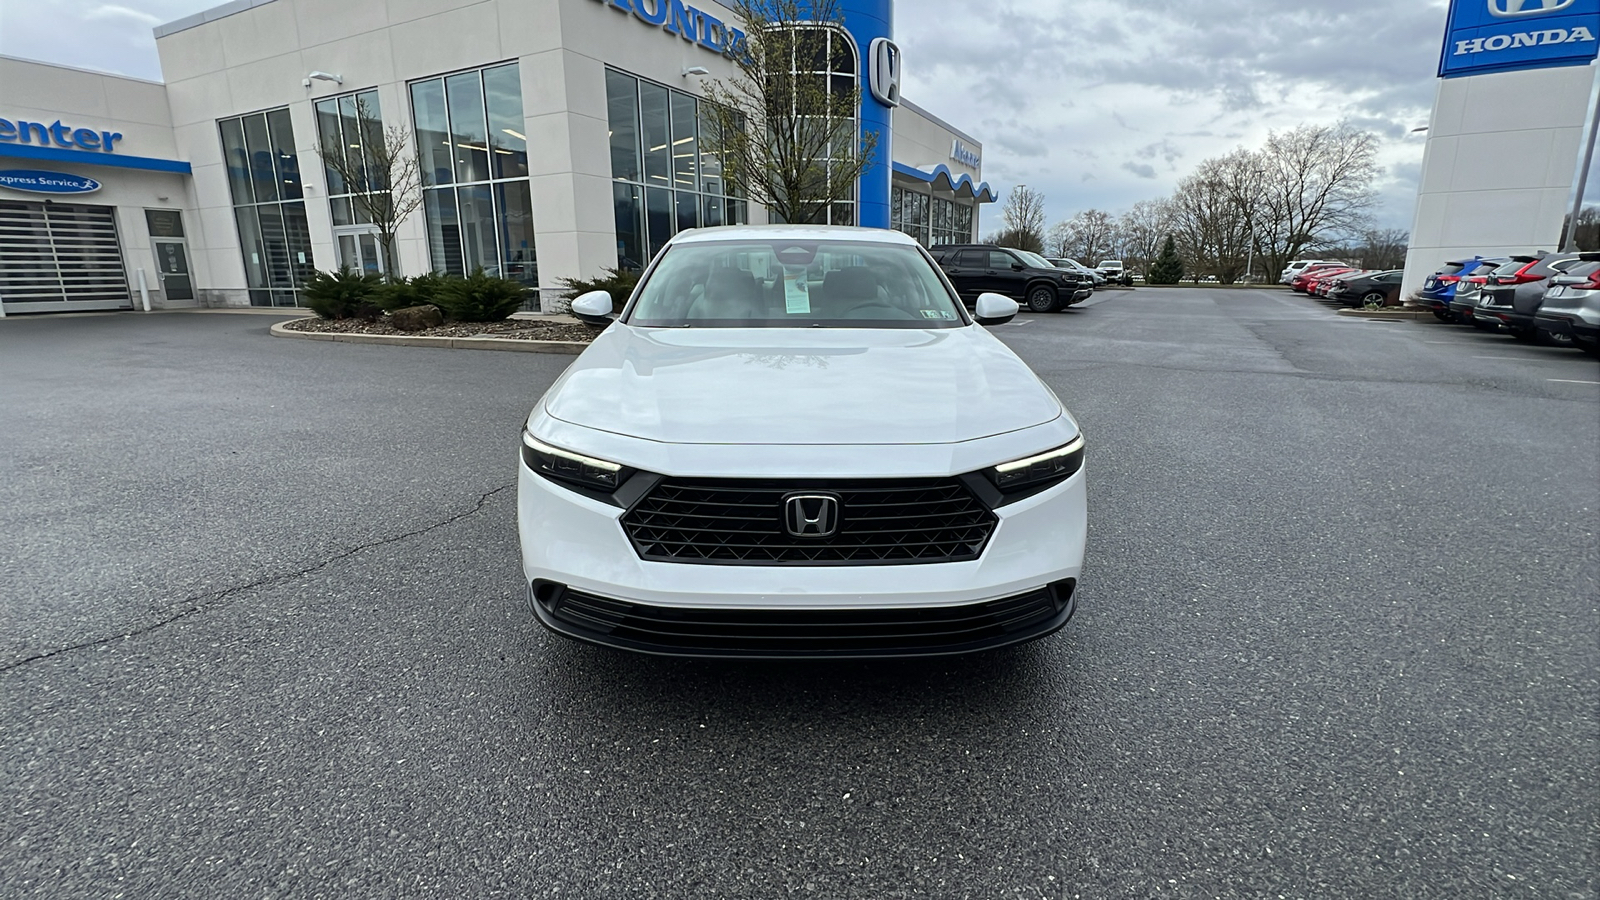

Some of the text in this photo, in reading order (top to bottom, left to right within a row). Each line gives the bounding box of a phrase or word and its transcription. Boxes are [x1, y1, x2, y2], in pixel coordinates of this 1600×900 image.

[603, 0, 753, 65] ONDA
[1453, 26, 1596, 56] HONDA
[38, 177, 79, 187] Service
